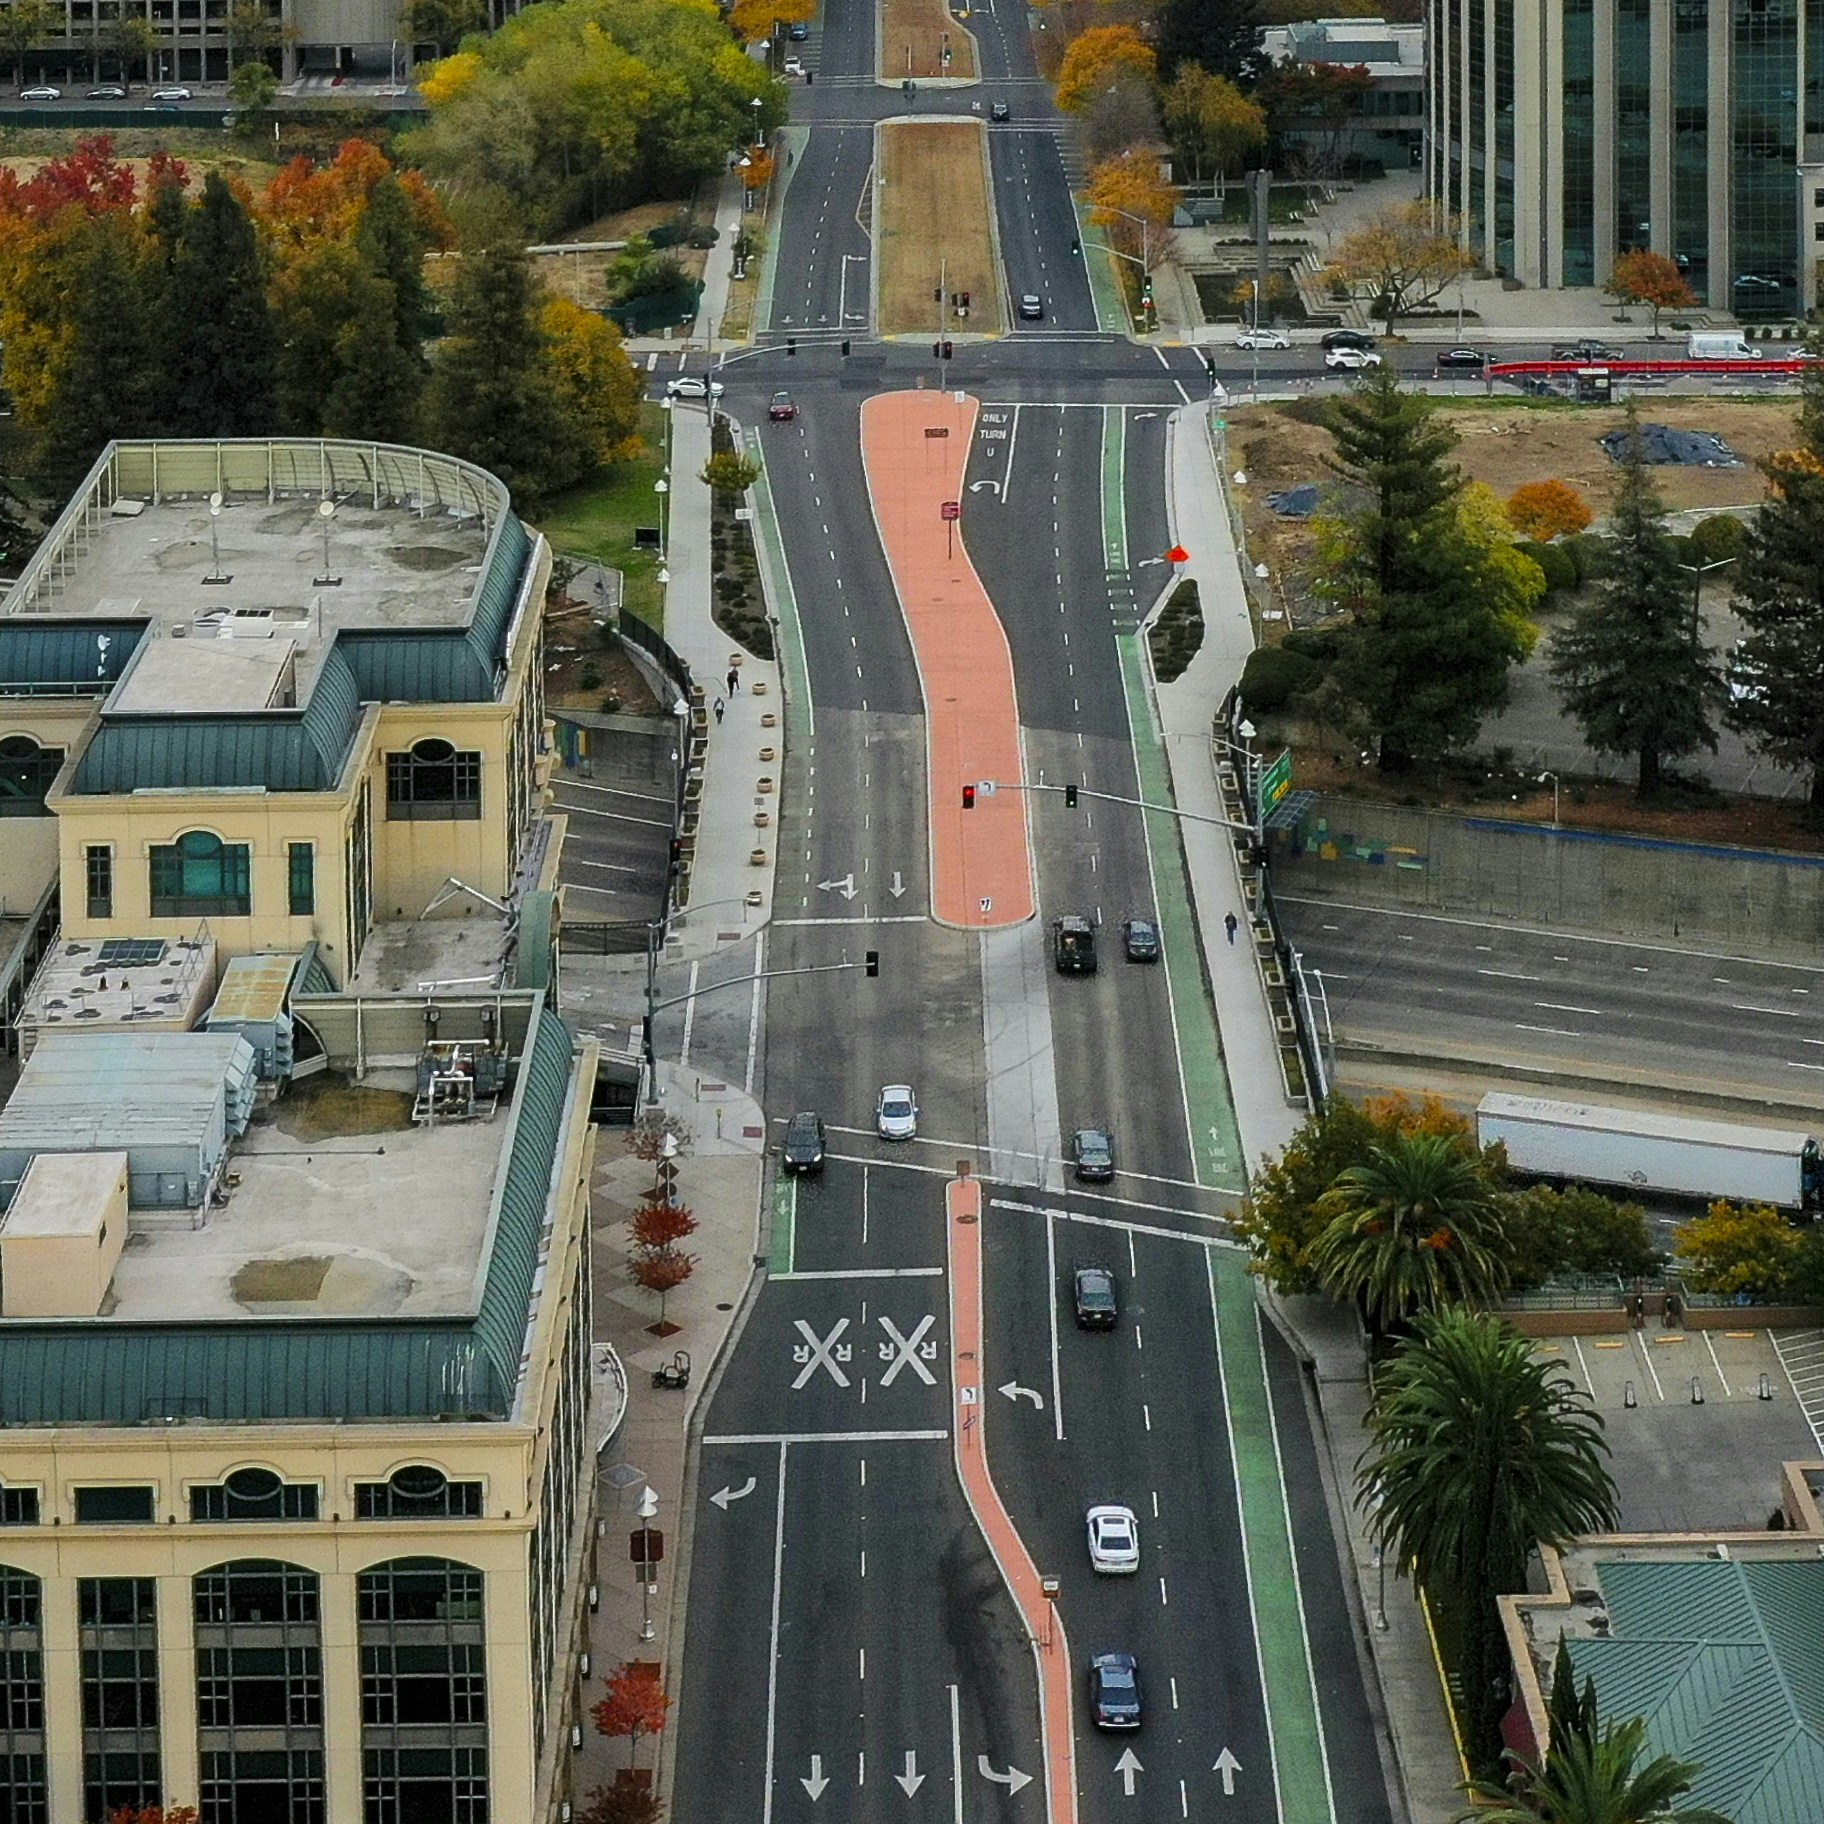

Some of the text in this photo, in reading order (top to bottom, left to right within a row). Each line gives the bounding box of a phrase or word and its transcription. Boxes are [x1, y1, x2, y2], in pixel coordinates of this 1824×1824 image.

[982, 413, 1008, 423] ONLY
[979, 429, 1007, 440] TURN
[986, 447, 995, 457] U
